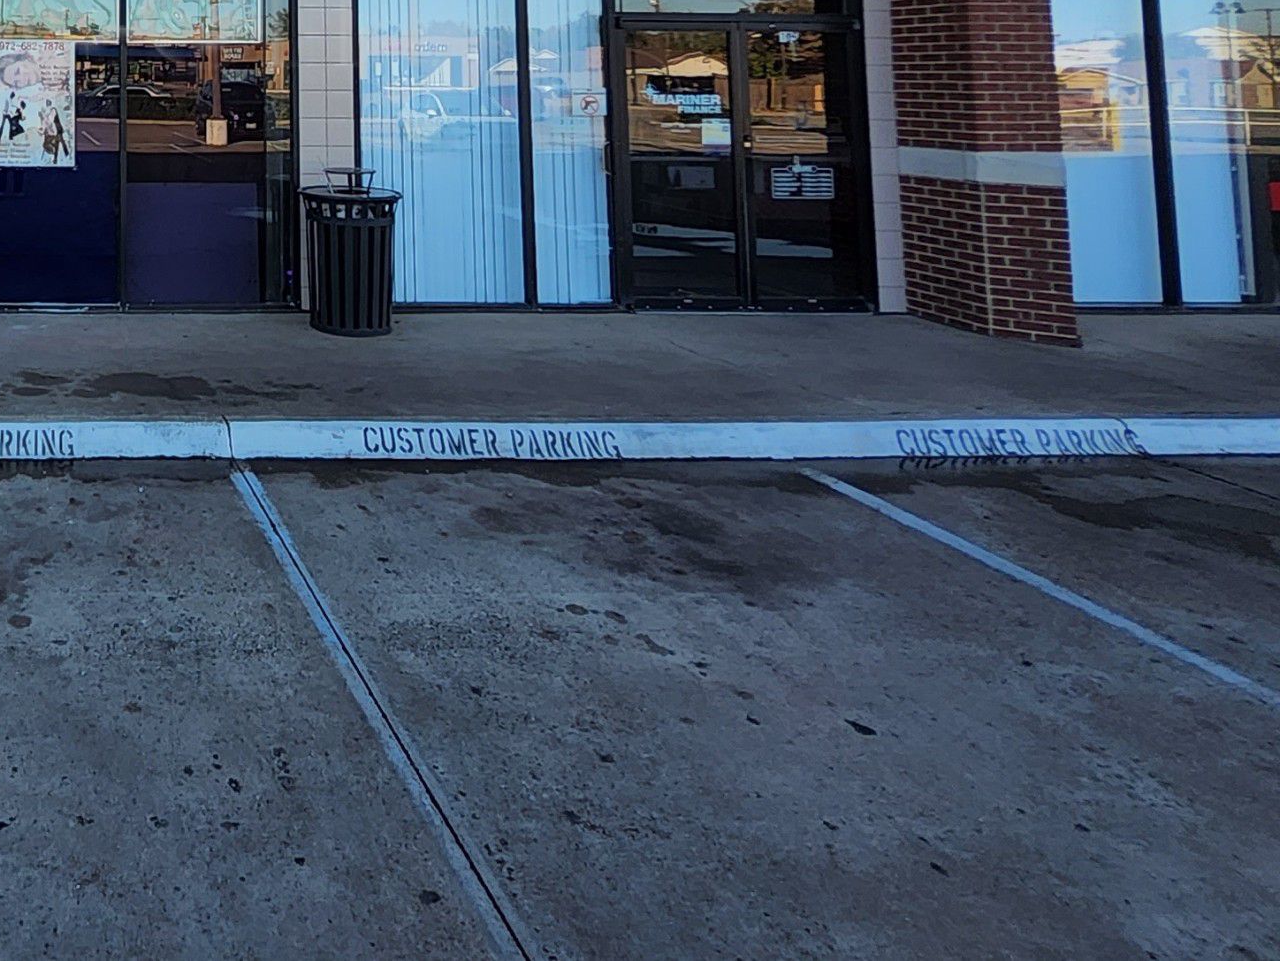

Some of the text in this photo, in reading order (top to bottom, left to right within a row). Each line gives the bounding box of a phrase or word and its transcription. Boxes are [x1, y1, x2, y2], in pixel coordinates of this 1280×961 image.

[652, 94, 722, 105] MARINER
[362, 426, 622, 459] CUSTOMER PARKING
[895, 428, 1149, 456] CUSTOMER PARKING
